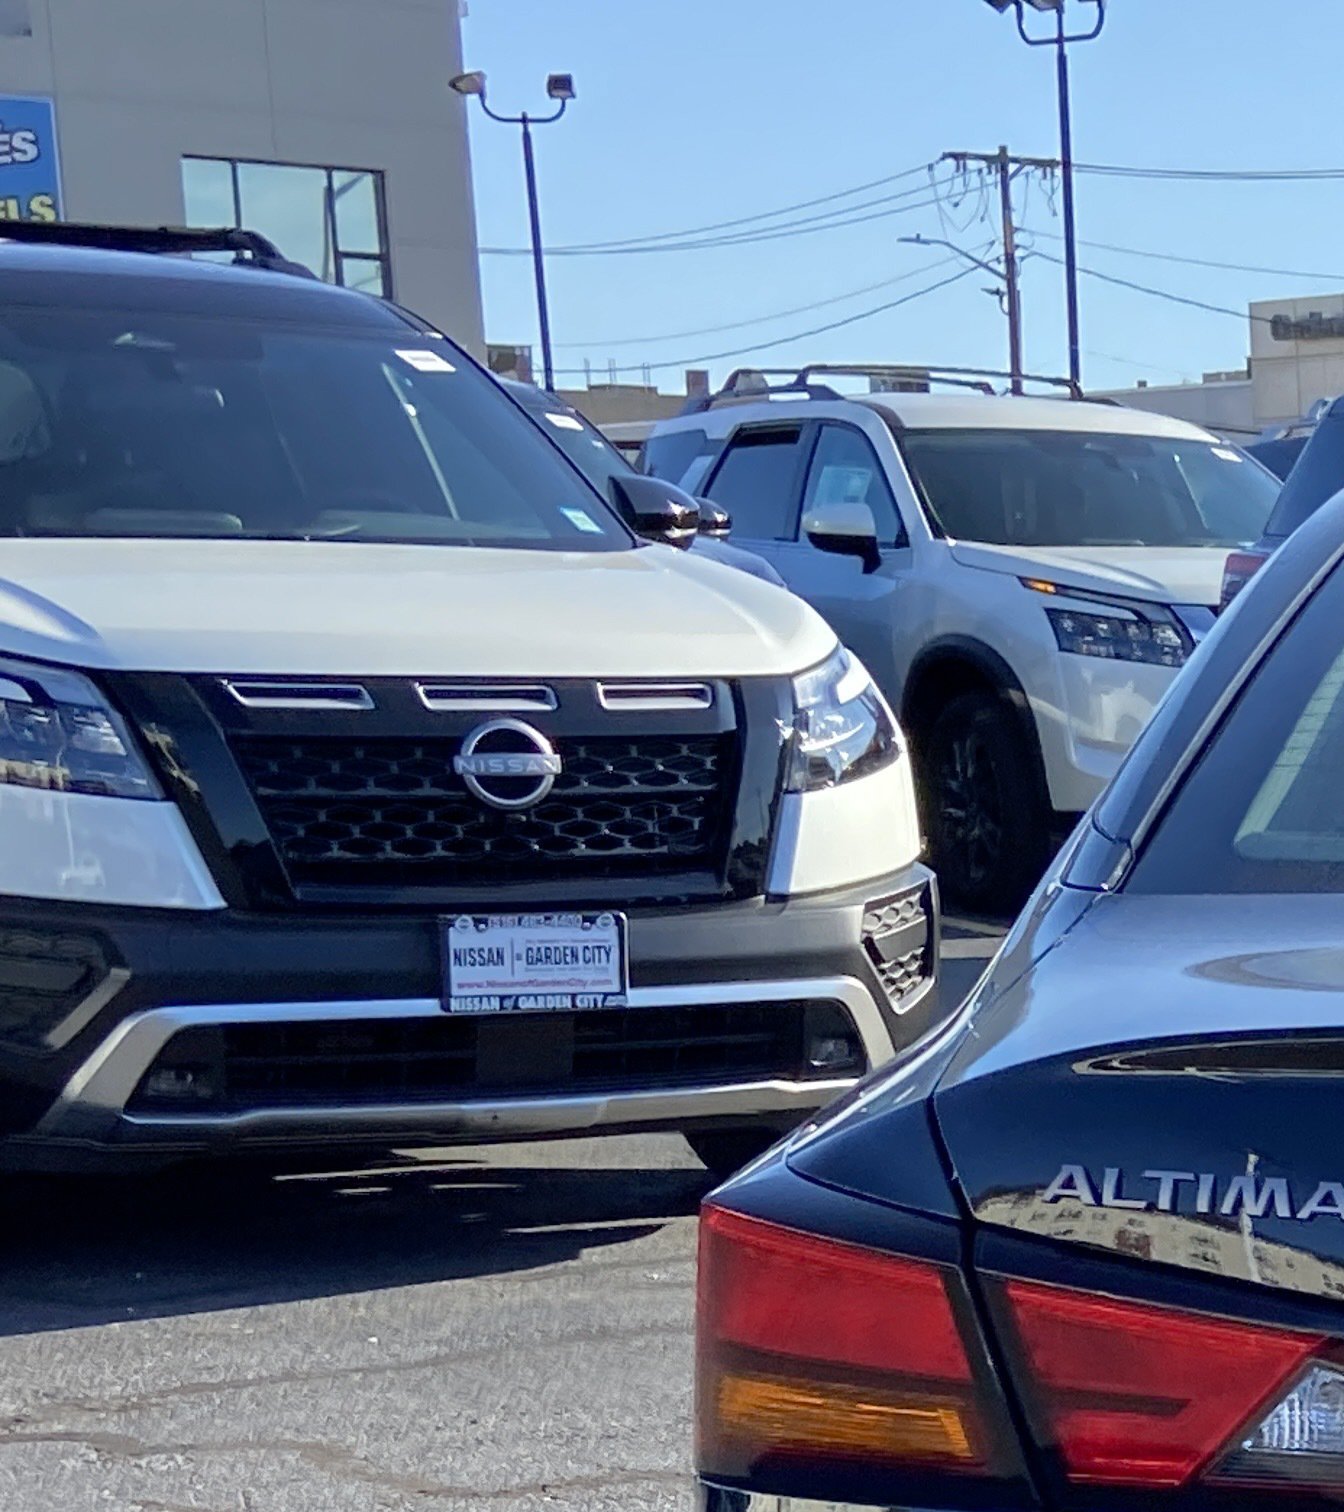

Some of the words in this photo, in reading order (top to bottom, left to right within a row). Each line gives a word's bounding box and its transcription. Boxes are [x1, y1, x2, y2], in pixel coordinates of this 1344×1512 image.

[459, 759, 559, 774] NISSAN
[453, 947, 505, 967] NISSAN
[525, 945, 579, 966] GARDEN
[582, 943, 612, 964] CITY
[450, 996, 500, 1012] NISSAN
[518, 995, 572, 1010] GARDEN
